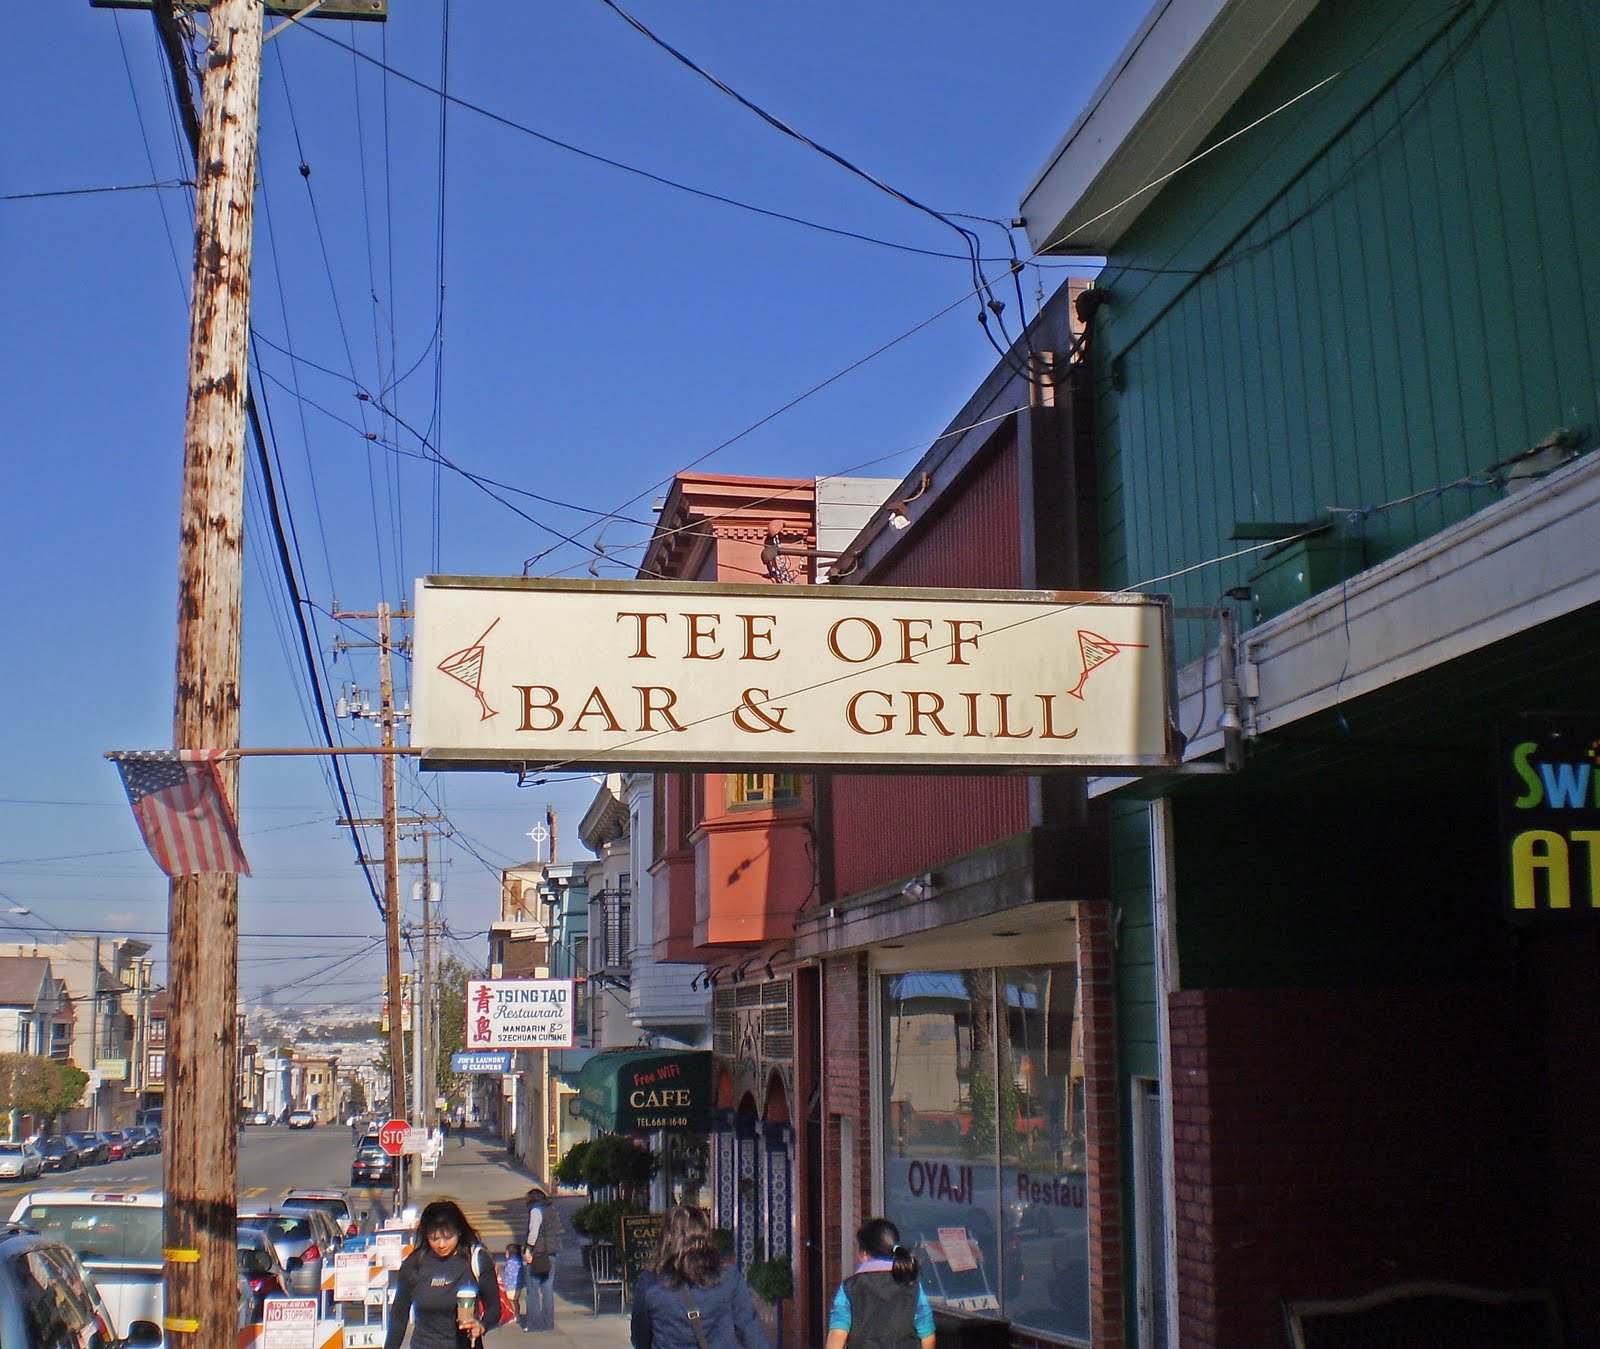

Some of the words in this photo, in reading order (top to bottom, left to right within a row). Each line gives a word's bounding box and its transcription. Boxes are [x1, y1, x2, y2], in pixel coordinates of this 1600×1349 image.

[616, 611, 781, 661] TEE
[827, 616, 984, 666] OFF
[513, 685, 687, 733] BAR
[732, 687, 795, 734] &
[845, 689, 1079, 740] GRILL
[493, 1005, 565, 1019] Restaurant
[502, 1025, 546, 1033] MANDARIN
[498, 1034, 537, 1042] SZECHUAN
[633, 1073, 656, 1087] Free
[629, 1089, 691, 1108] CAFE
[382, 1130, 404, 1144] STO
[908, 1160, 974, 1205] OYAJI
[272, 1301, 310, 1309] TOW-AWAY
[268, 1309, 282, 1321] NO
[283, 1309, 314, 1320] STOPPING
